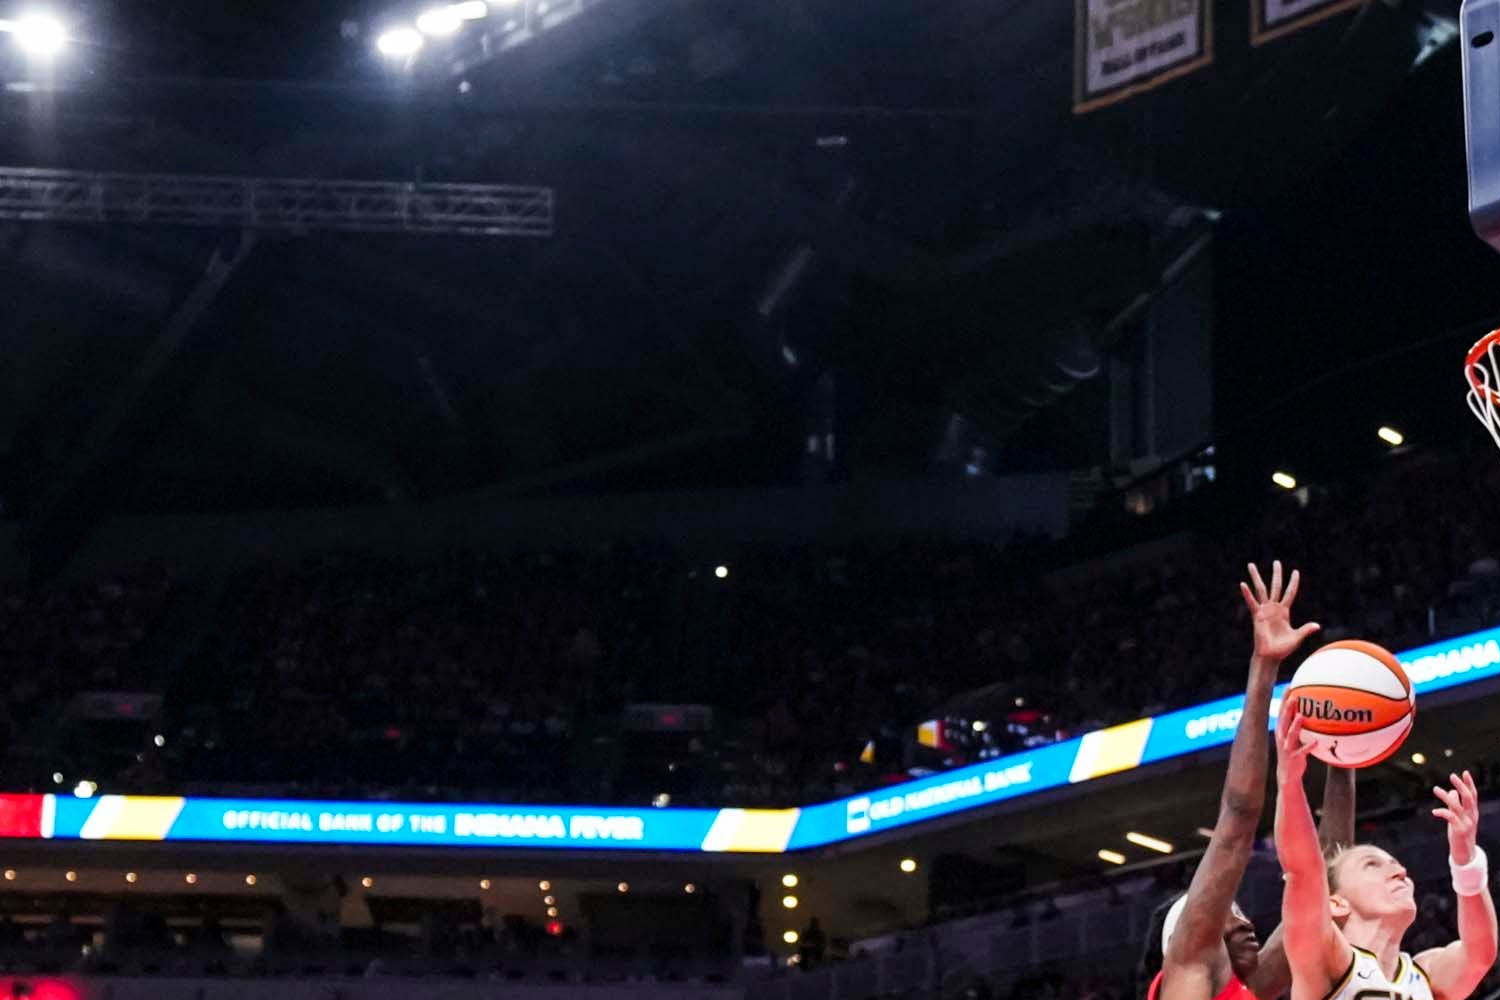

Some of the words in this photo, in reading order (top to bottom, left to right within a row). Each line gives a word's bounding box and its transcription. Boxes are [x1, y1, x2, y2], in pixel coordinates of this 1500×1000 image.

[1185, 708, 1243, 739] OFFIC
[1297, 696, 1373, 722] Wilson
[223, 810, 313, 831] OFFICIAL
[319, 812, 373, 832] BANK
[376, 813, 403, 833] OF
[409, 814, 446, 834] THE
[454, 813, 567, 838] INDIANA
[569, 815, 644, 840] FEVER
